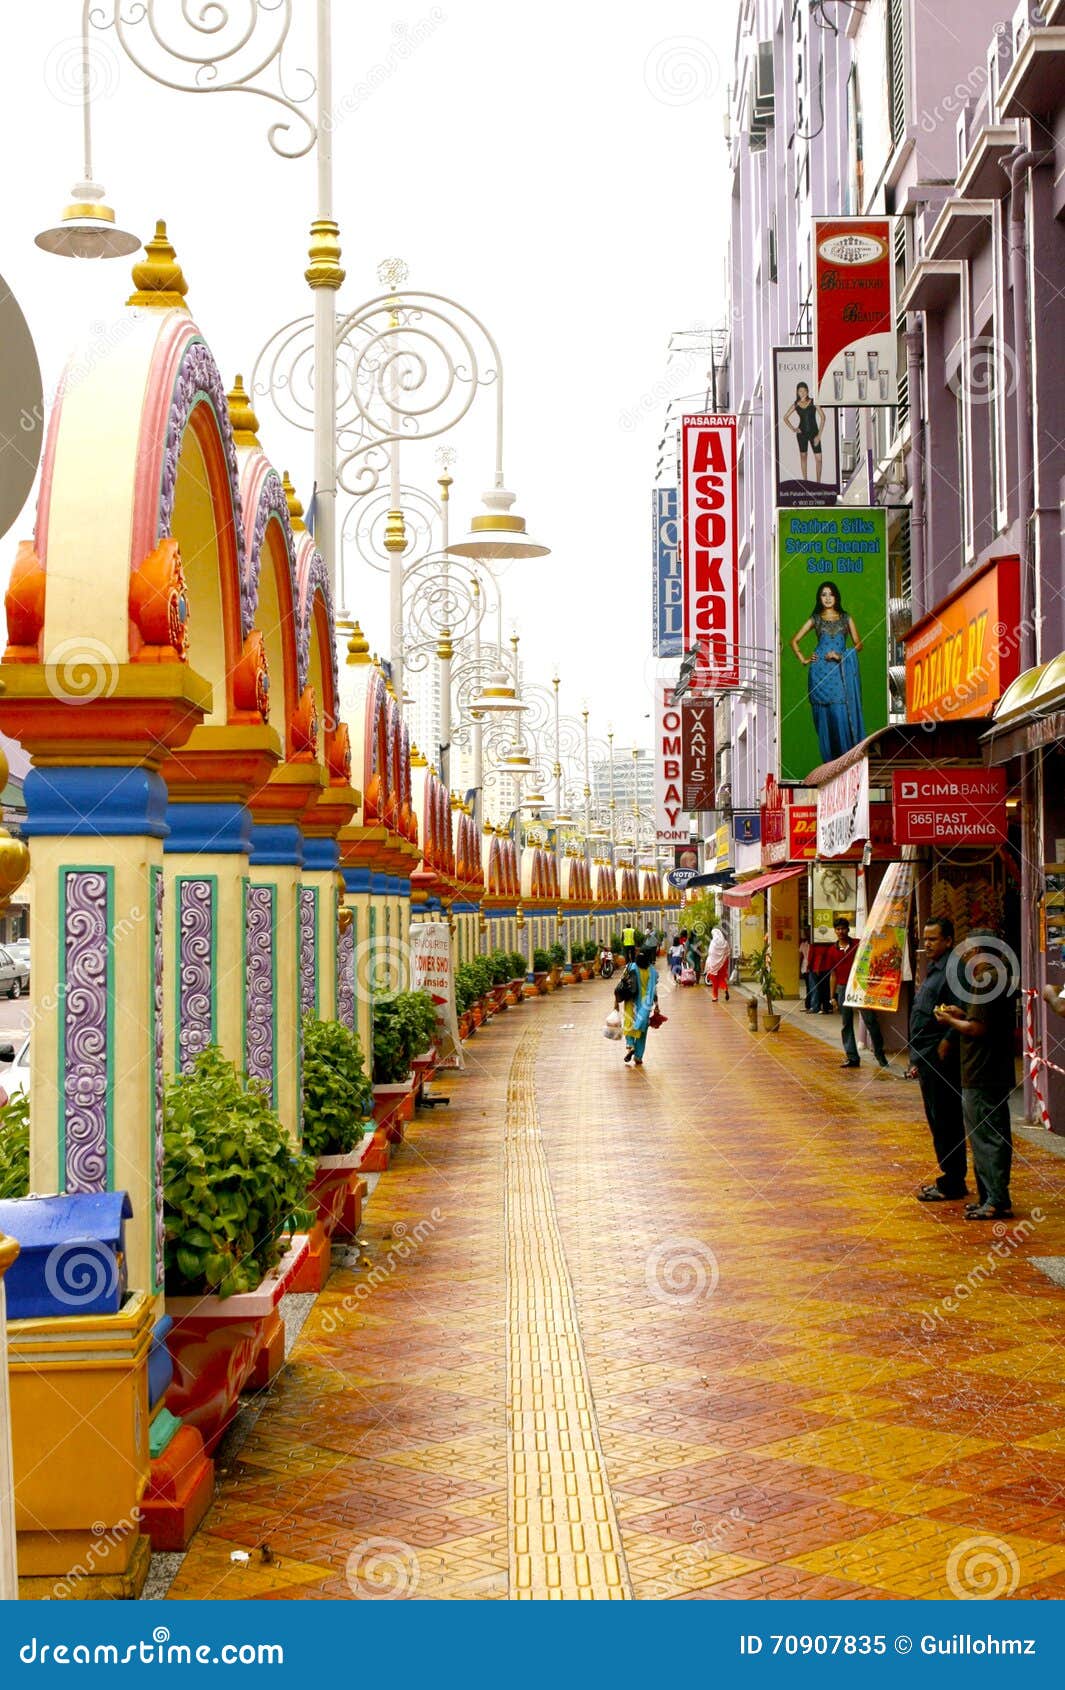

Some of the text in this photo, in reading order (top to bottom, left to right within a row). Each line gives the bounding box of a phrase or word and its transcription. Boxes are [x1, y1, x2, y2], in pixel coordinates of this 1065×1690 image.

[683, 416, 736, 426] PASARAYA
[790, 518, 875, 533] Rathna Silks
[785, 538, 880, 553] Store Chennai
[660, 490, 682, 634] HOTEL
[807, 557, 863, 573] Sdn Bhd
[662, 688, 682, 827] BOMBAY
[910, 813, 967, 825] 365 FAST
[656, 830, 689, 840] POINT
[936, 824, 996, 835] BANKING
